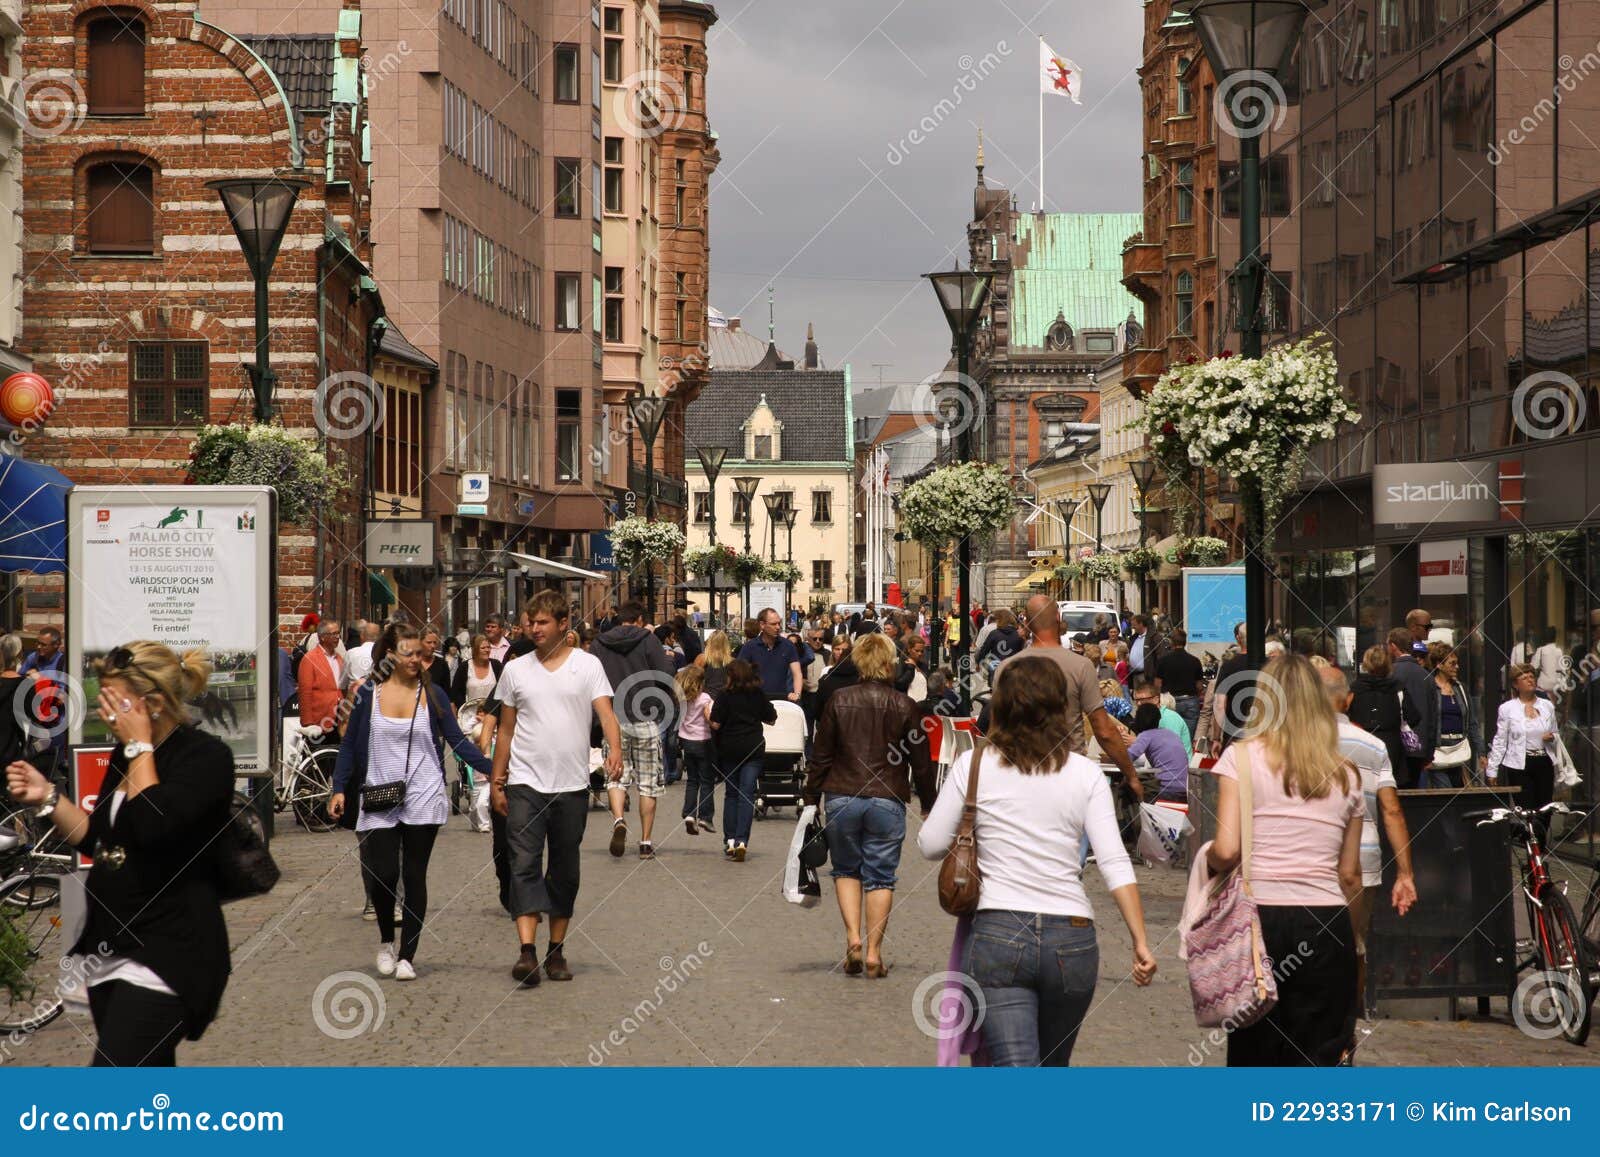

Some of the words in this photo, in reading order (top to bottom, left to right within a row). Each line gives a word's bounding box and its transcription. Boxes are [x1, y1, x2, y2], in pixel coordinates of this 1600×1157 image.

[1386, 480, 1489, 502] stadium
[129, 530, 180, 542] MALMÖ
[184, 532, 214, 542] CITY
[129, 547, 172, 557] HORSE
[175, 547, 214, 557] SHOW
[379, 544, 421, 554] PEAK
[154, 565, 192, 573] AUGUSTI
[193, 565, 214, 573] 2010
[129, 575, 178, 585] VÄRLDSCUP
[181, 577, 199, 585] OCH
[200, 577, 214, 585] SM
[153, 624, 163, 632] Fri
